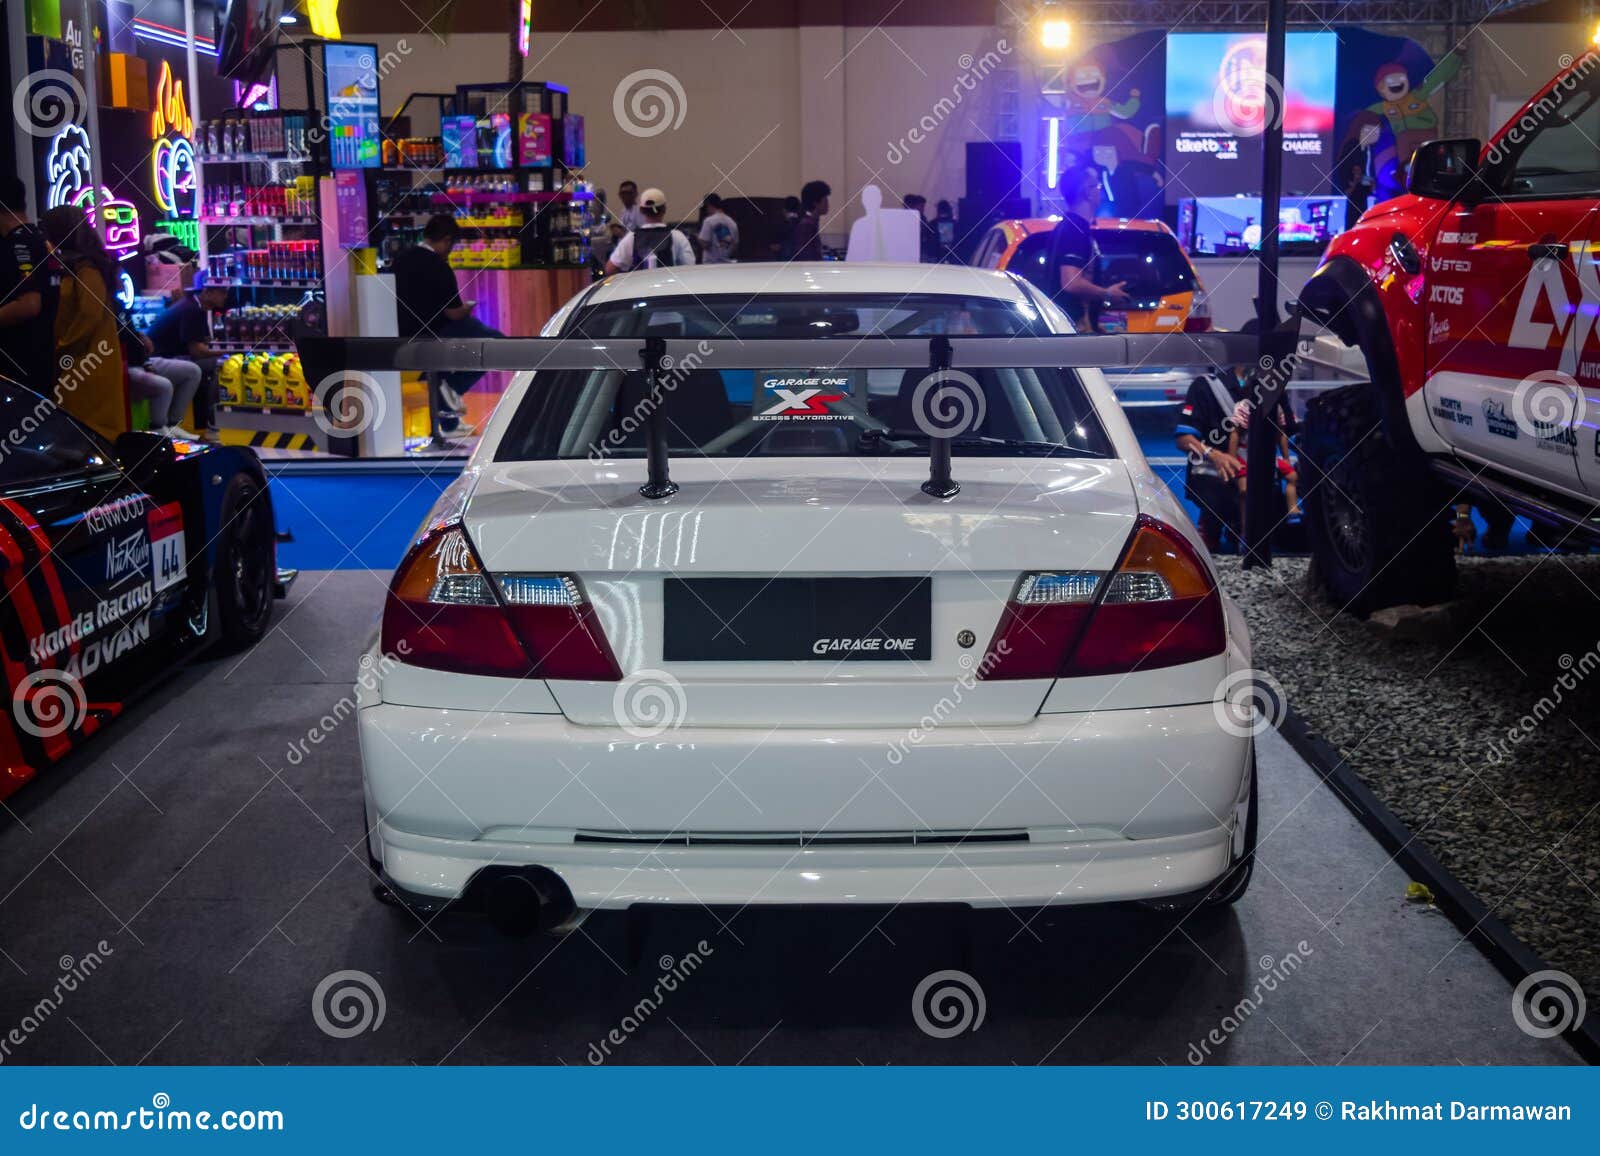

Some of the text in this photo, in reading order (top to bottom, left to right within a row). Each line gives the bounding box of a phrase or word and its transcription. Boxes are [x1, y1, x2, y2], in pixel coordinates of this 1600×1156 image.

[764, 378, 848, 388] GARAGE ONE
[83, 492, 145, 536] KENWOOD
[162, 539, 179, 580] 44
[30, 612, 95, 665] Honda
[97, 581, 152, 629] Racing
[62, 613, 151, 680] ADVAN
[813, 638, 917, 654] GARAGE ONE
